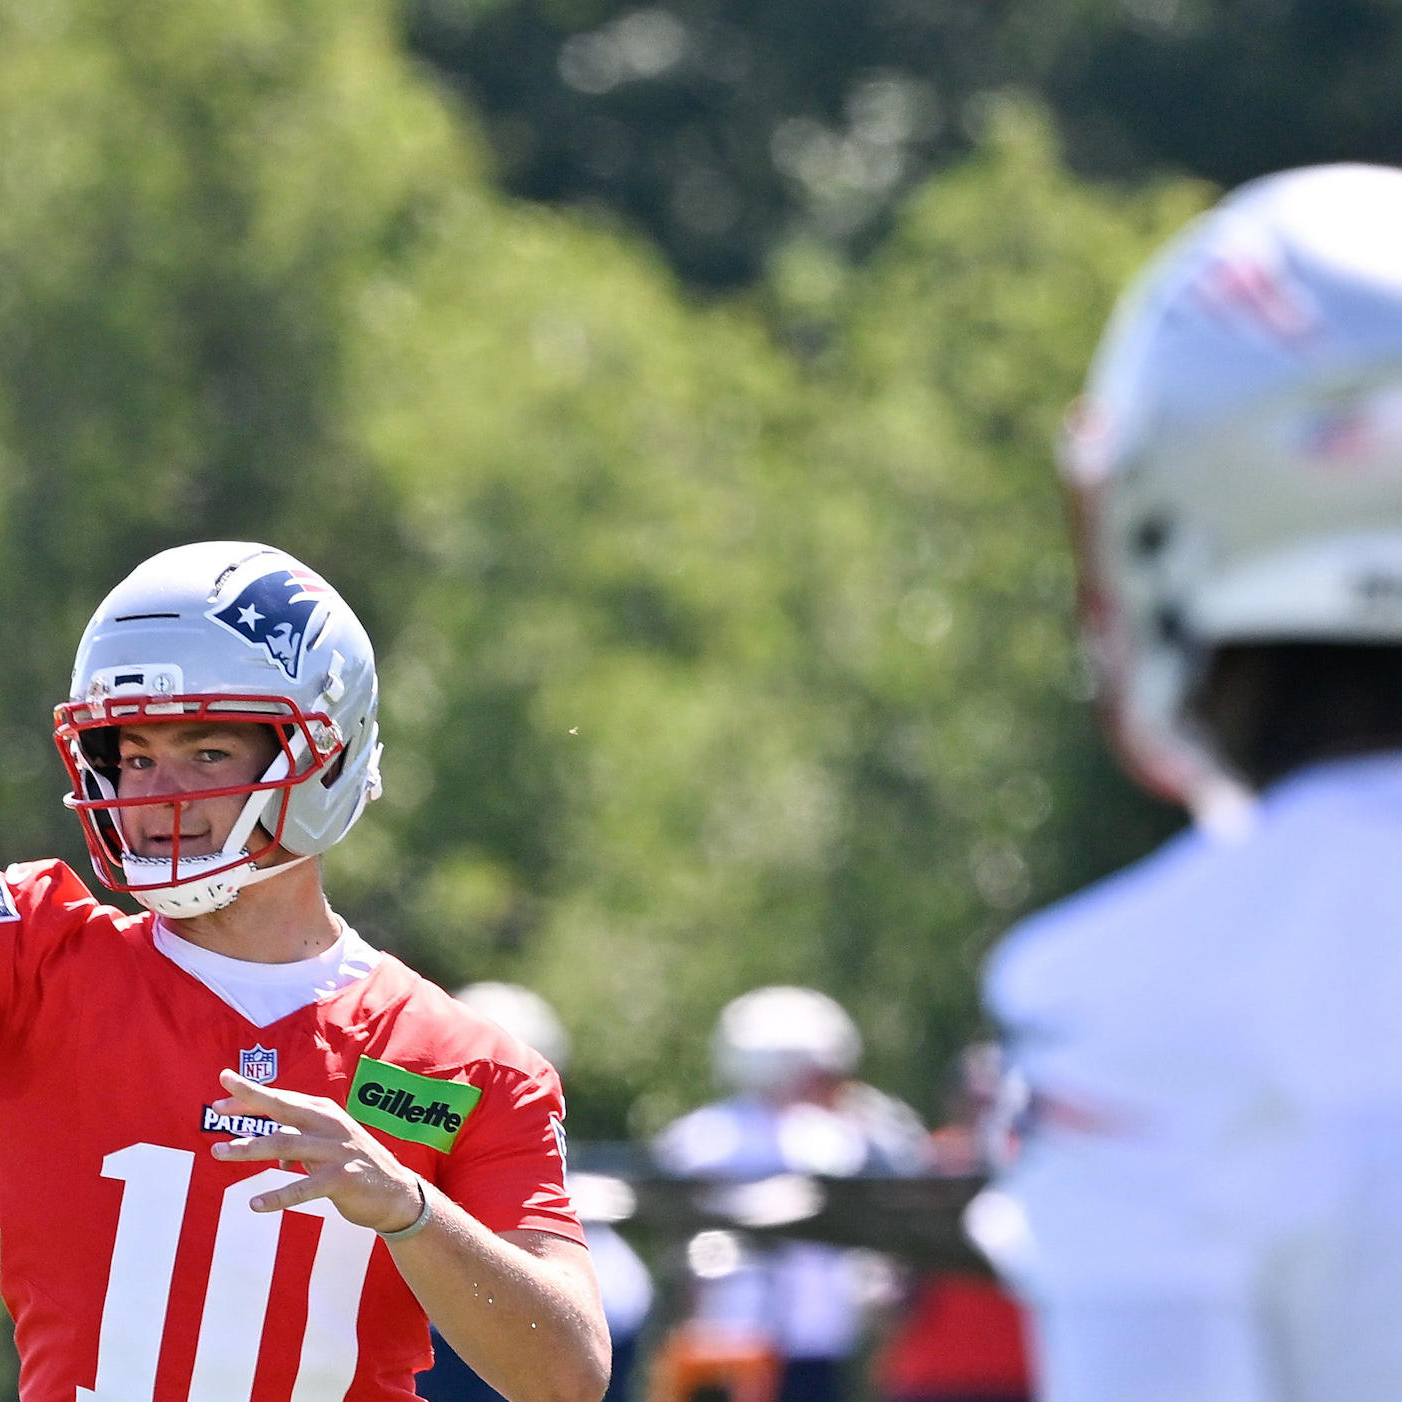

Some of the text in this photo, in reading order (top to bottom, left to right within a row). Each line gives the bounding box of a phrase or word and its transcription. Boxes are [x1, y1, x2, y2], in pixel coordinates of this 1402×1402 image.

[246, 1063, 271, 1079] NFL
[203, 1107, 279, 1137] PATRIO
[358, 1082, 462, 1133] Gillette
